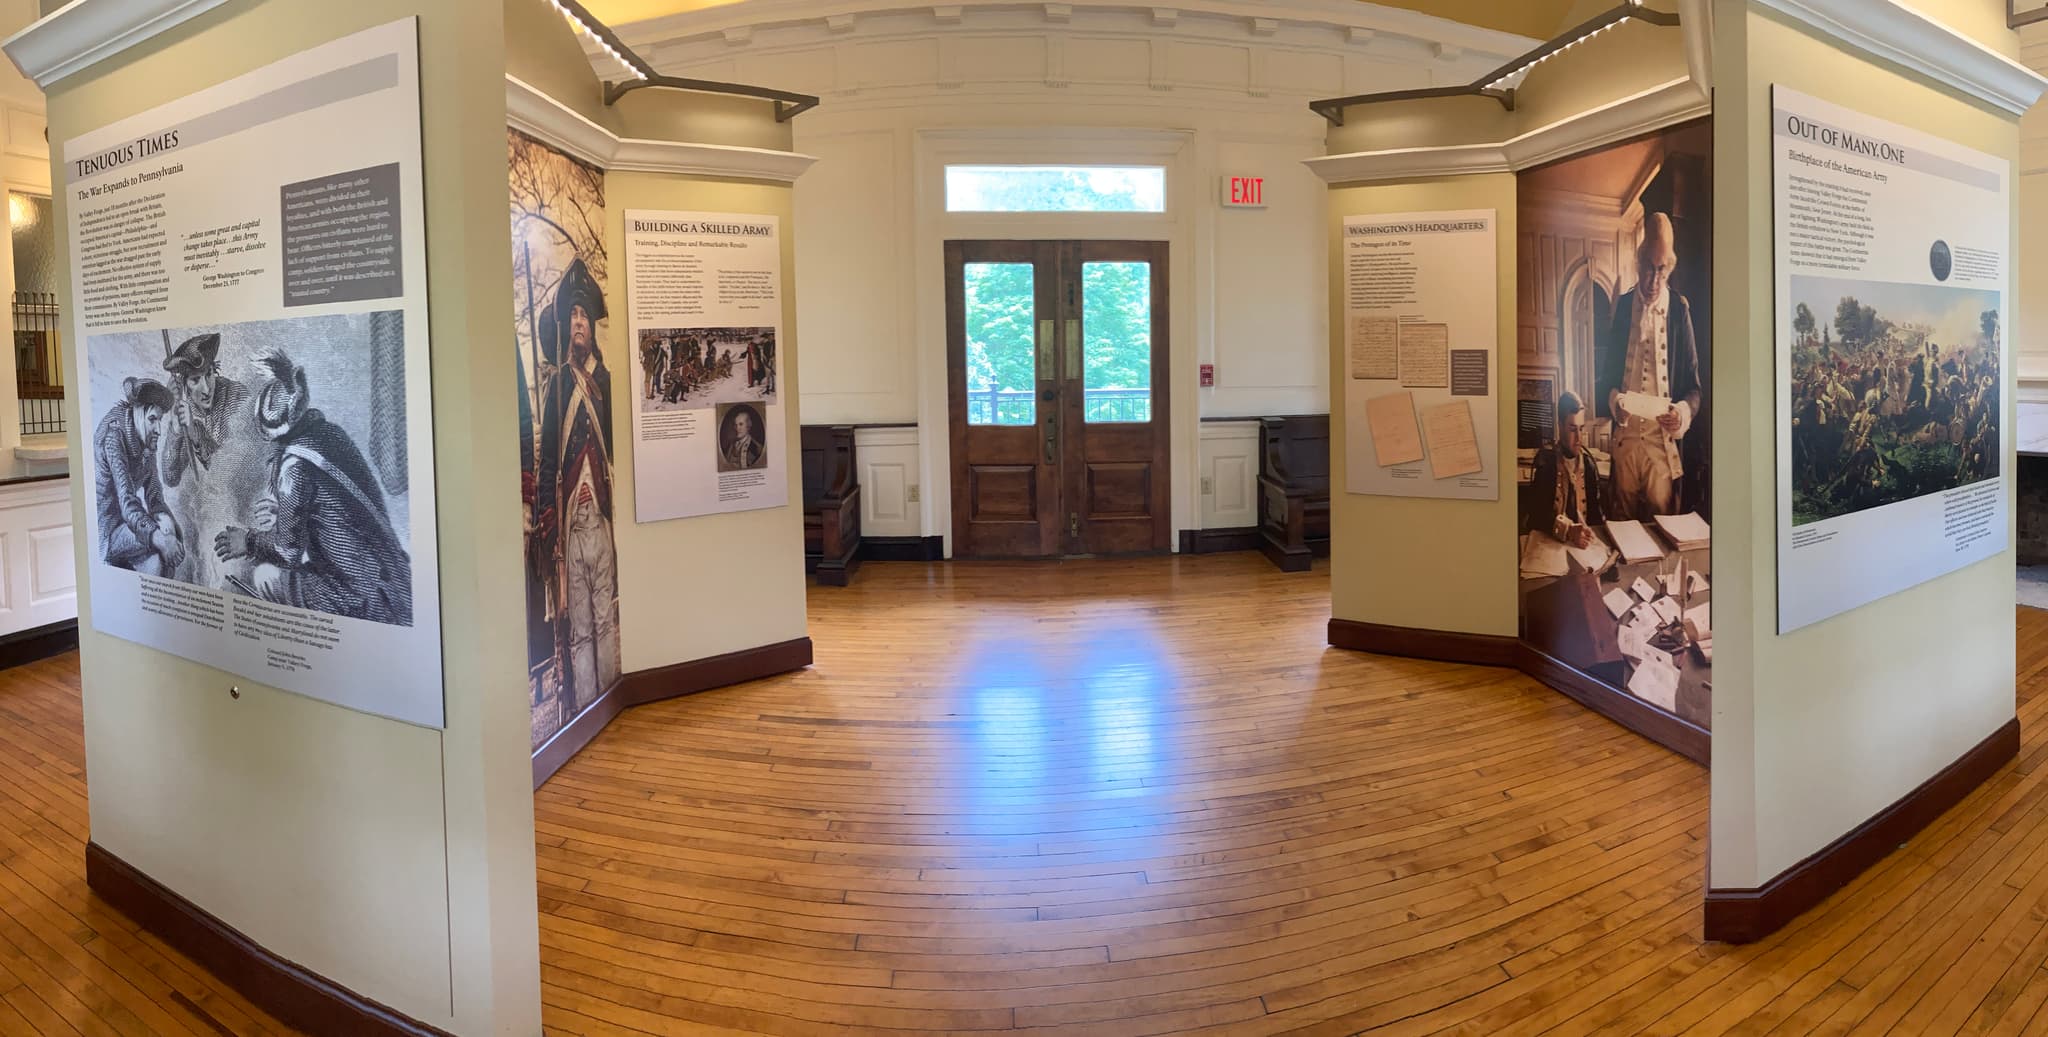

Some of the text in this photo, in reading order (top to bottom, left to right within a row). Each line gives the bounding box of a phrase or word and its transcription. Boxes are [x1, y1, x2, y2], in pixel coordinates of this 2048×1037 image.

[1788, 116, 1818, 140] OUT
[1822, 128, 1838, 146] OF
[1880, 143, 1904, 164] ONE
[76, 130, 178, 177] TENUOUS TIMES
[1788, 149, 1888, 184] Birthplace of the American Army
[78, 162, 184, 200] The War Expands to Pennsylvania
[1231, 177, 1263, 204] EXIT
[231, 222, 241, 232] and
[242, 218, 260, 231] capital
[634, 220, 770, 236] BUILDING A SKILLED ARMY
[1415, 222, 1484, 232] HEADQUARTERS
[243, 232, 258, 241] Army
[245, 241, 266, 251] dissolve
[217, 271, 240, 280] Washington
